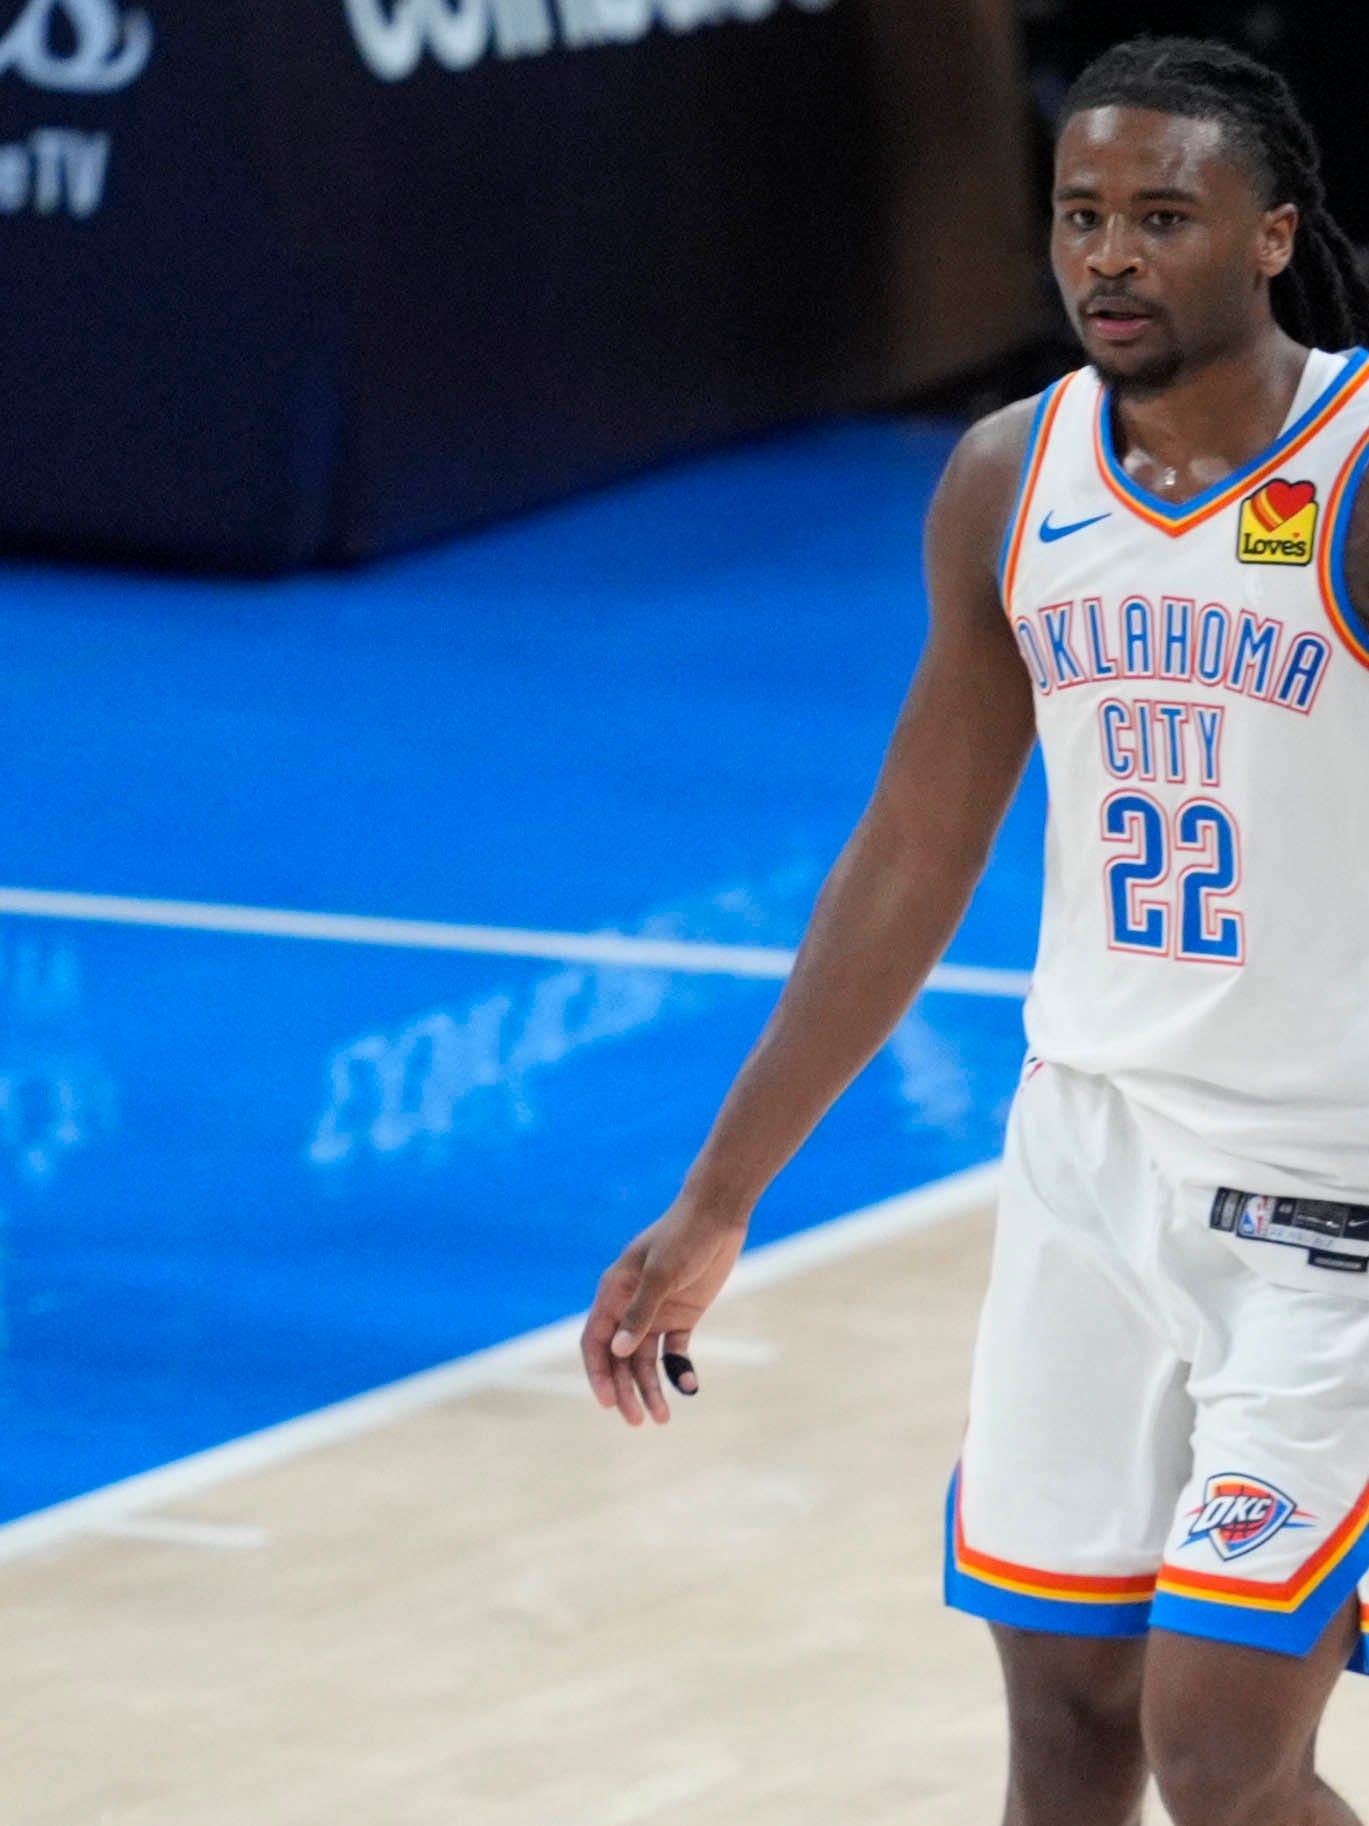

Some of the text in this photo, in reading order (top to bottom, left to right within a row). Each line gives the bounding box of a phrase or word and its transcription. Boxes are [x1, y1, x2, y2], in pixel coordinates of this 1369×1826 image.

[1014, 595, 1331, 715] OKLAHOMA
[1098, 698, 1225, 787] CITY
[1101, 788, 1246, 965] 22
[1190, 1495, 1273, 1535] OKC
